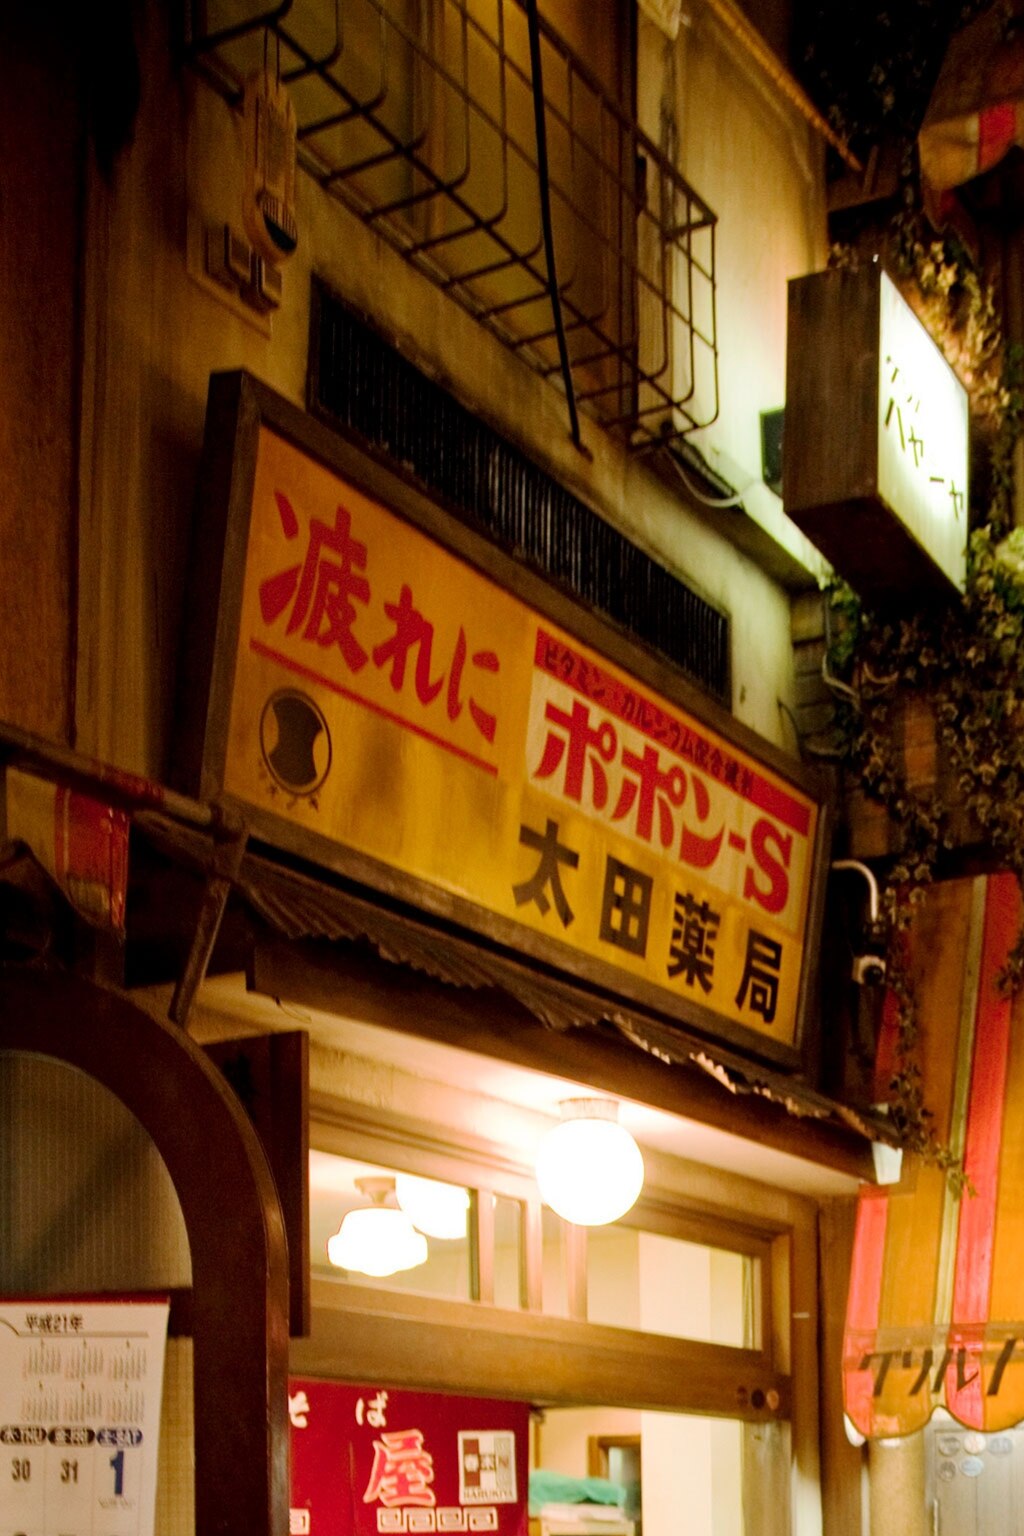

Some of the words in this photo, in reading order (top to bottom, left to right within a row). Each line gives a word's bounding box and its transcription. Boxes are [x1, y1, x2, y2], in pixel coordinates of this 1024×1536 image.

[258, 490, 502, 744] 疲れに
[511, 817, 783, 1025] 太田薬局
[12, 1457, 30, 1482] 30
[61, 1459, 79, 1484] 31
[109, 1450, 125, 1496] 1
[364, 1429, 436, 1507] 屋
